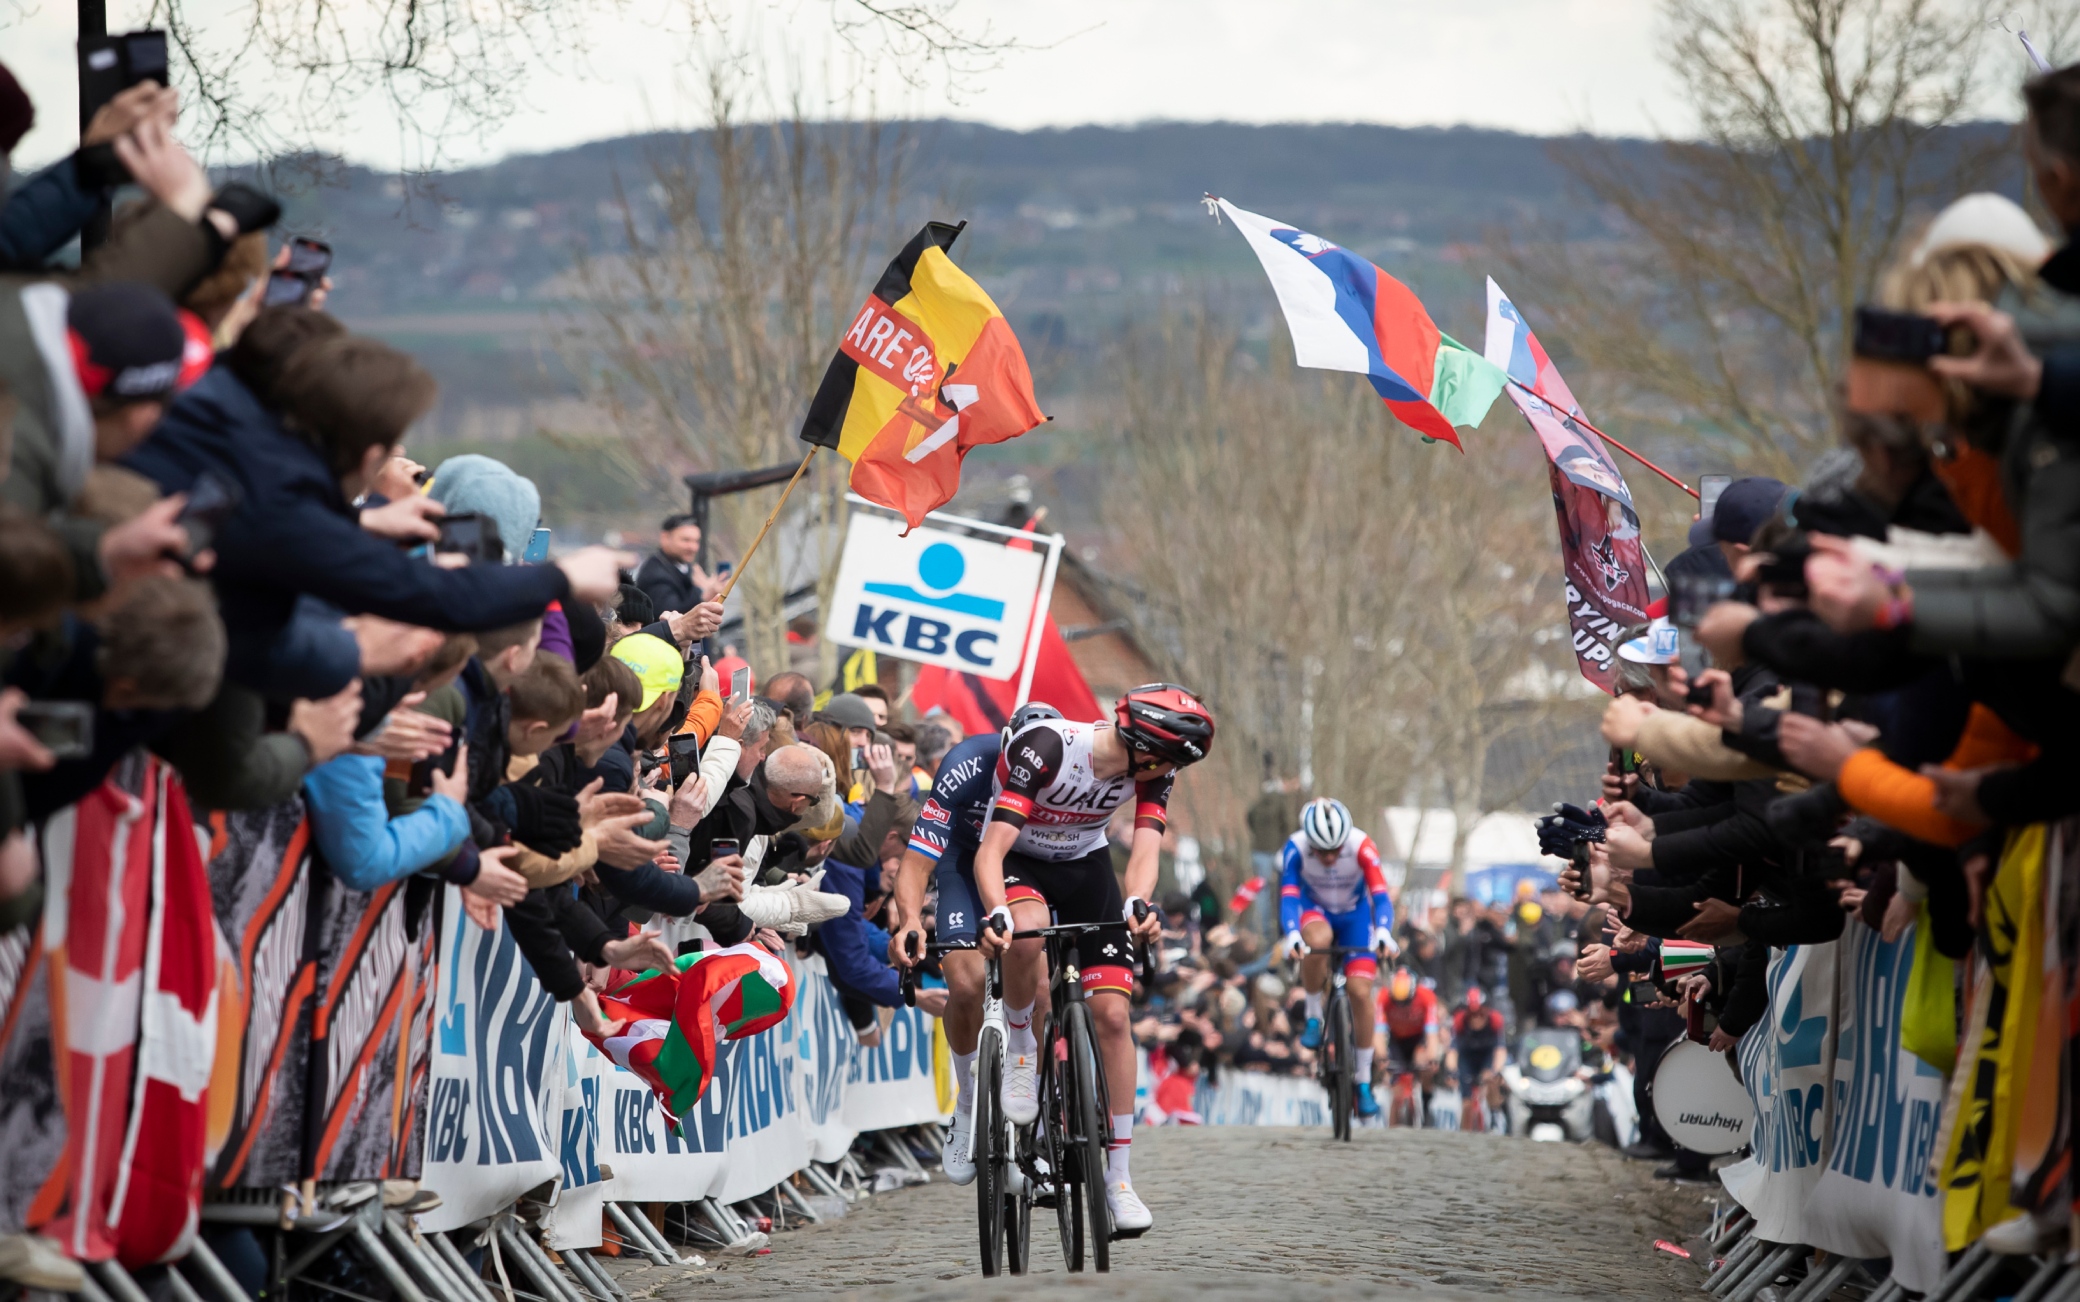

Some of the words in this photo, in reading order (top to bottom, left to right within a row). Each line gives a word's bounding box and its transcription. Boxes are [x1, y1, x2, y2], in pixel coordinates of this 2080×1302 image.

[853, 604, 999, 666] KBC
[936, 756, 982, 799] FENIX
[1020, 746, 1043, 769] FAB
[1046, 782, 1124, 810] UAE
[427, 1077, 471, 1164] KBC
[615, 1089, 656, 1154] KBC
